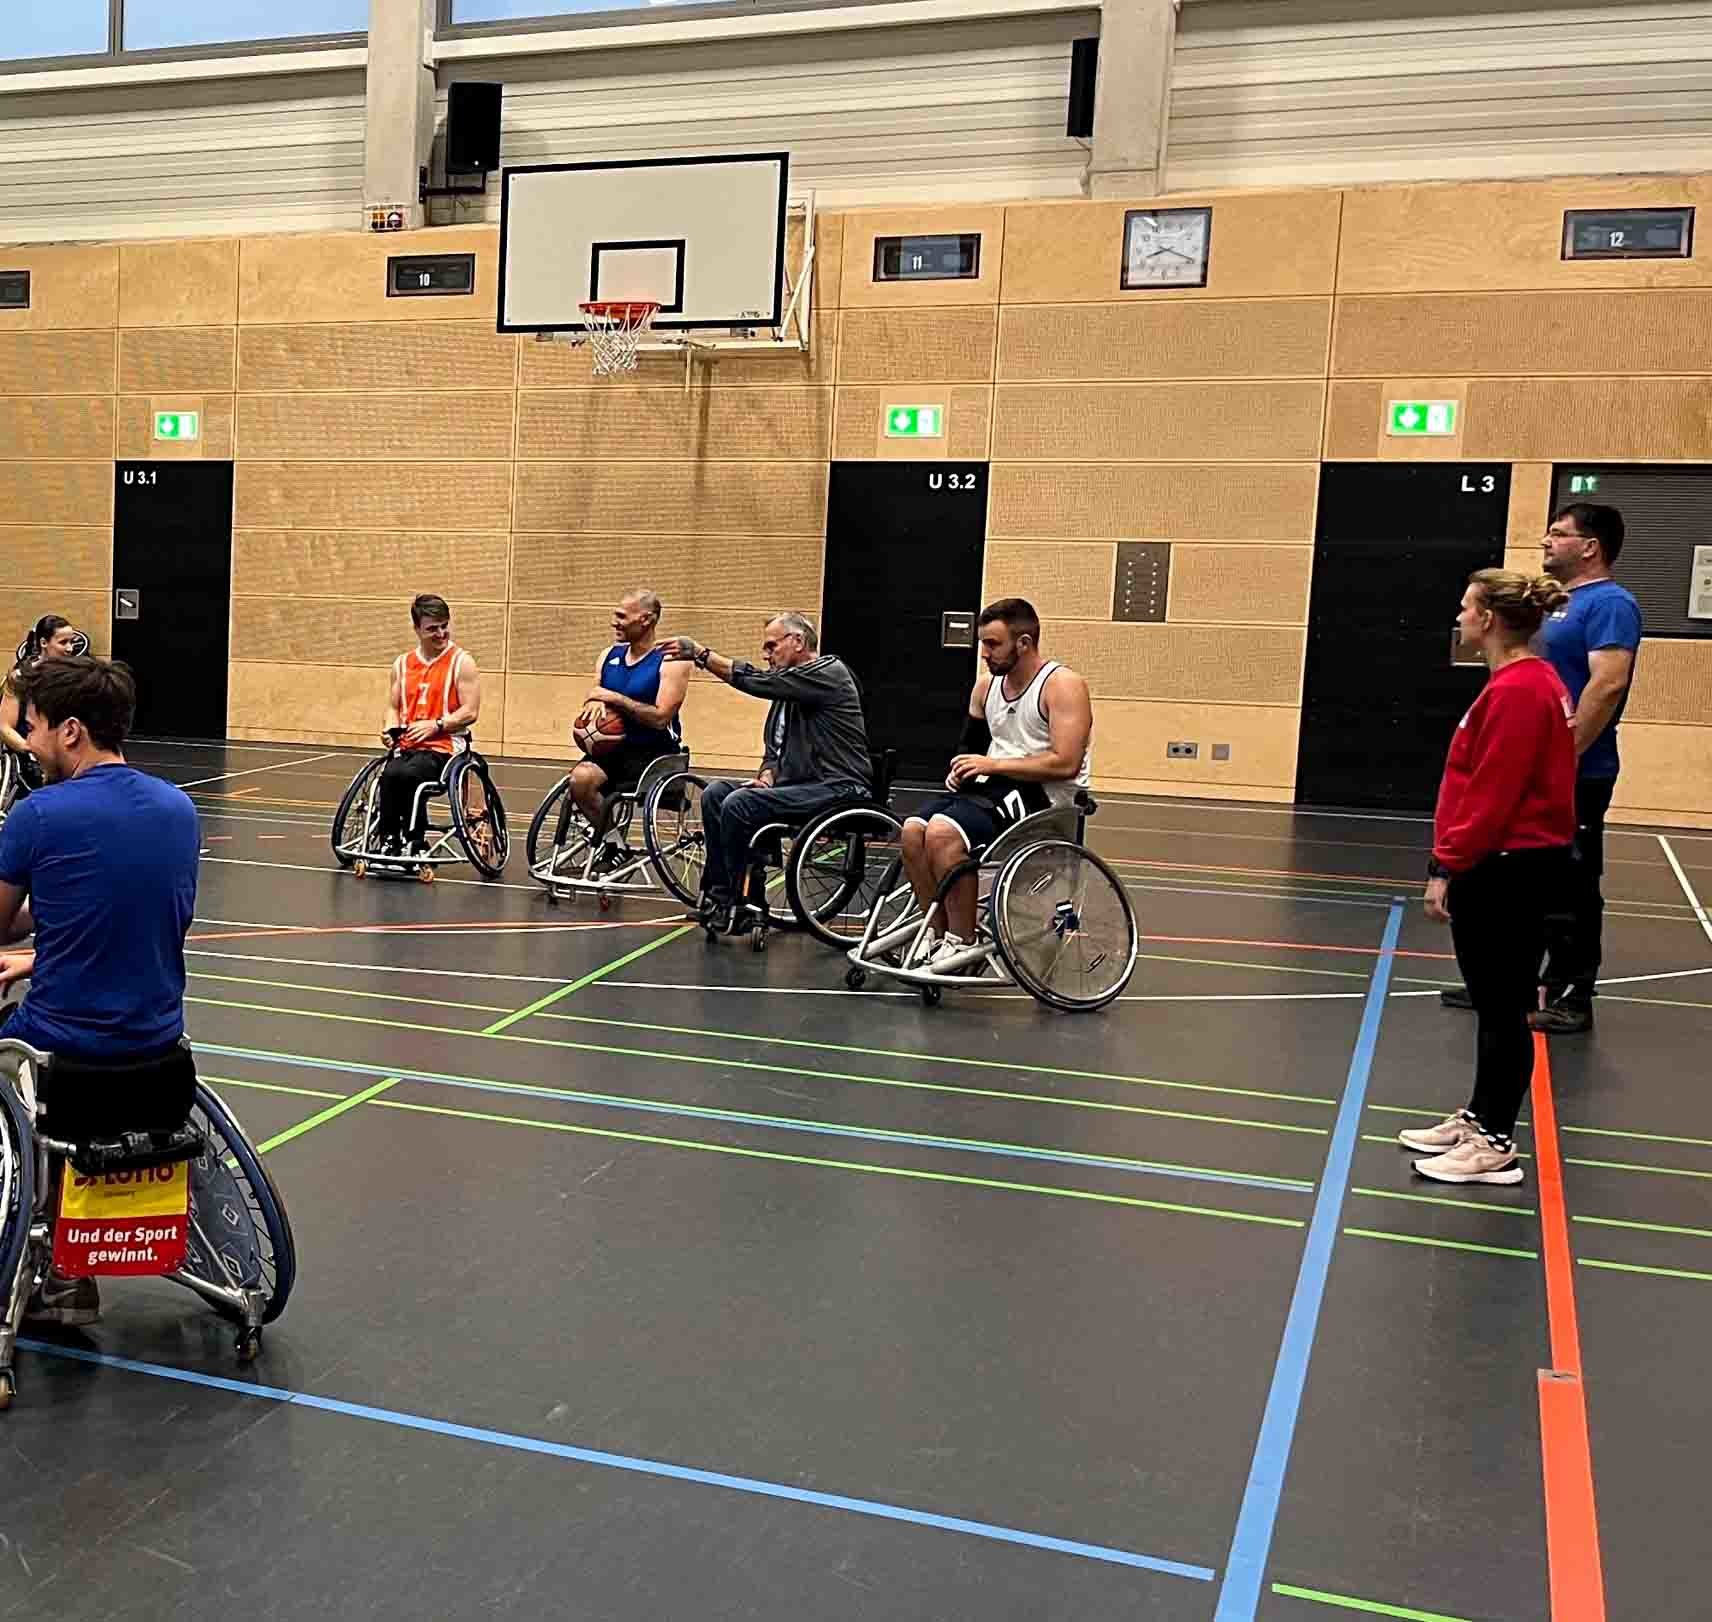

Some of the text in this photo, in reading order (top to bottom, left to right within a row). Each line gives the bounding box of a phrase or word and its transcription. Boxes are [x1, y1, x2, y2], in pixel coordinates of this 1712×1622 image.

[1609, 231, 1625, 248] 12
[912, 255, 923, 270] 11
[419, 273, 430, 287] 10
[124, 470, 157, 485] U 3.1
[929, 473, 976, 489] U 3.2
[1461, 474, 1495, 493] L 3
[67, 1225, 177, 1246] Und der Sport
[87, 1246, 158, 1266] gewinnt.
